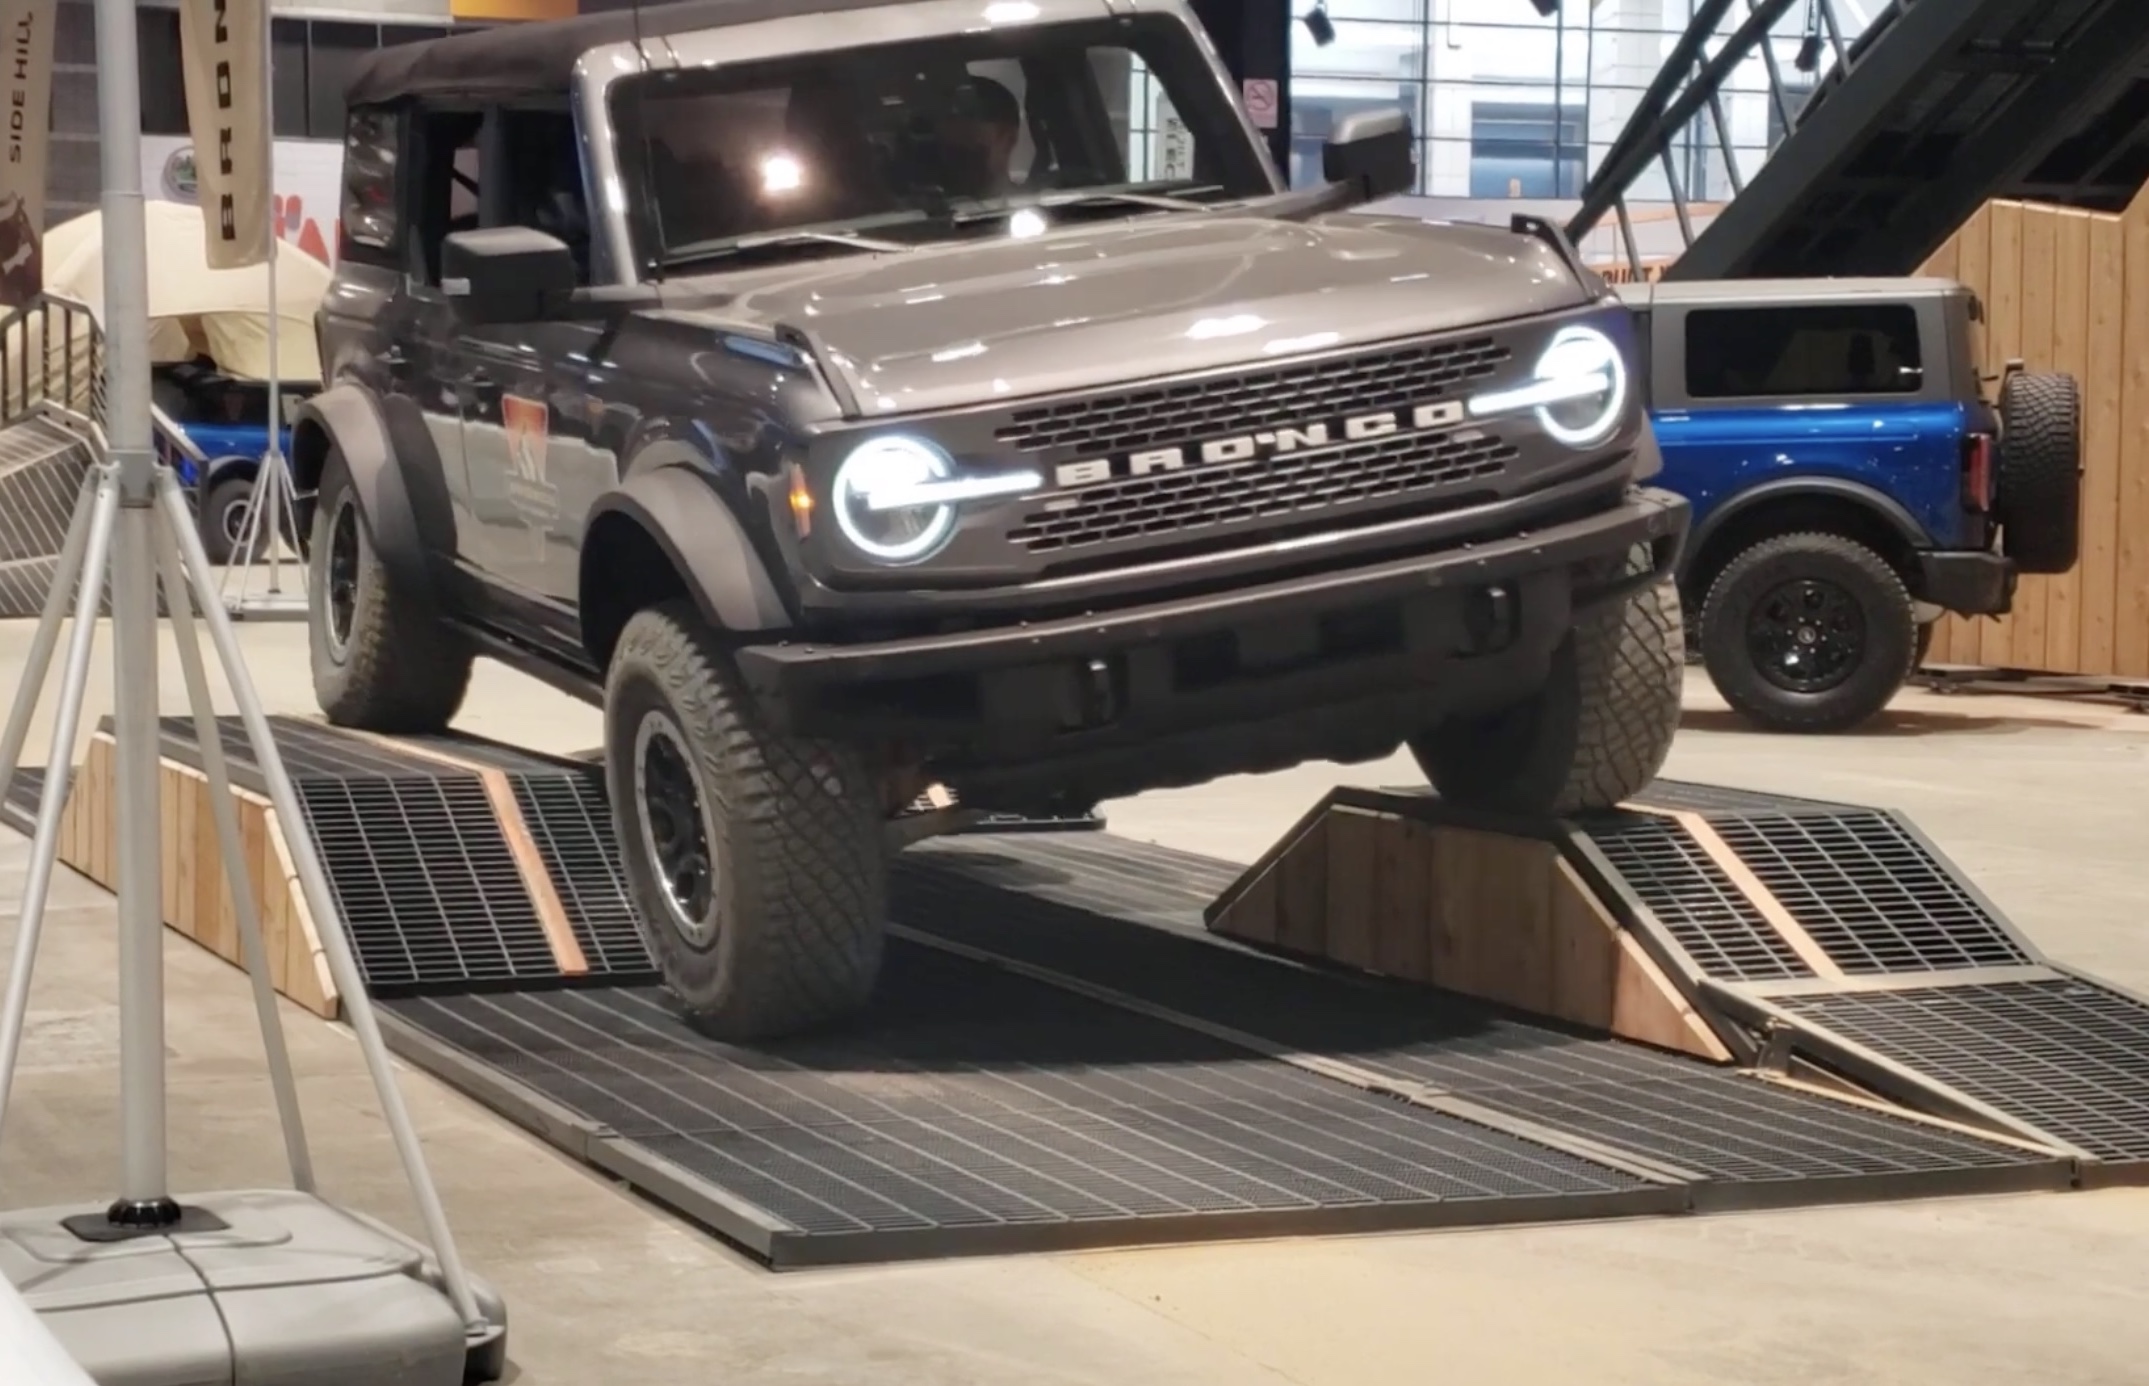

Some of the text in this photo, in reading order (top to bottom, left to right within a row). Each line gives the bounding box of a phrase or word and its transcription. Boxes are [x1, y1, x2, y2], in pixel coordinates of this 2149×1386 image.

[9, 11, 34, 164] SIDE HILL
[1055, 400, 1464, 487] BRONCO
